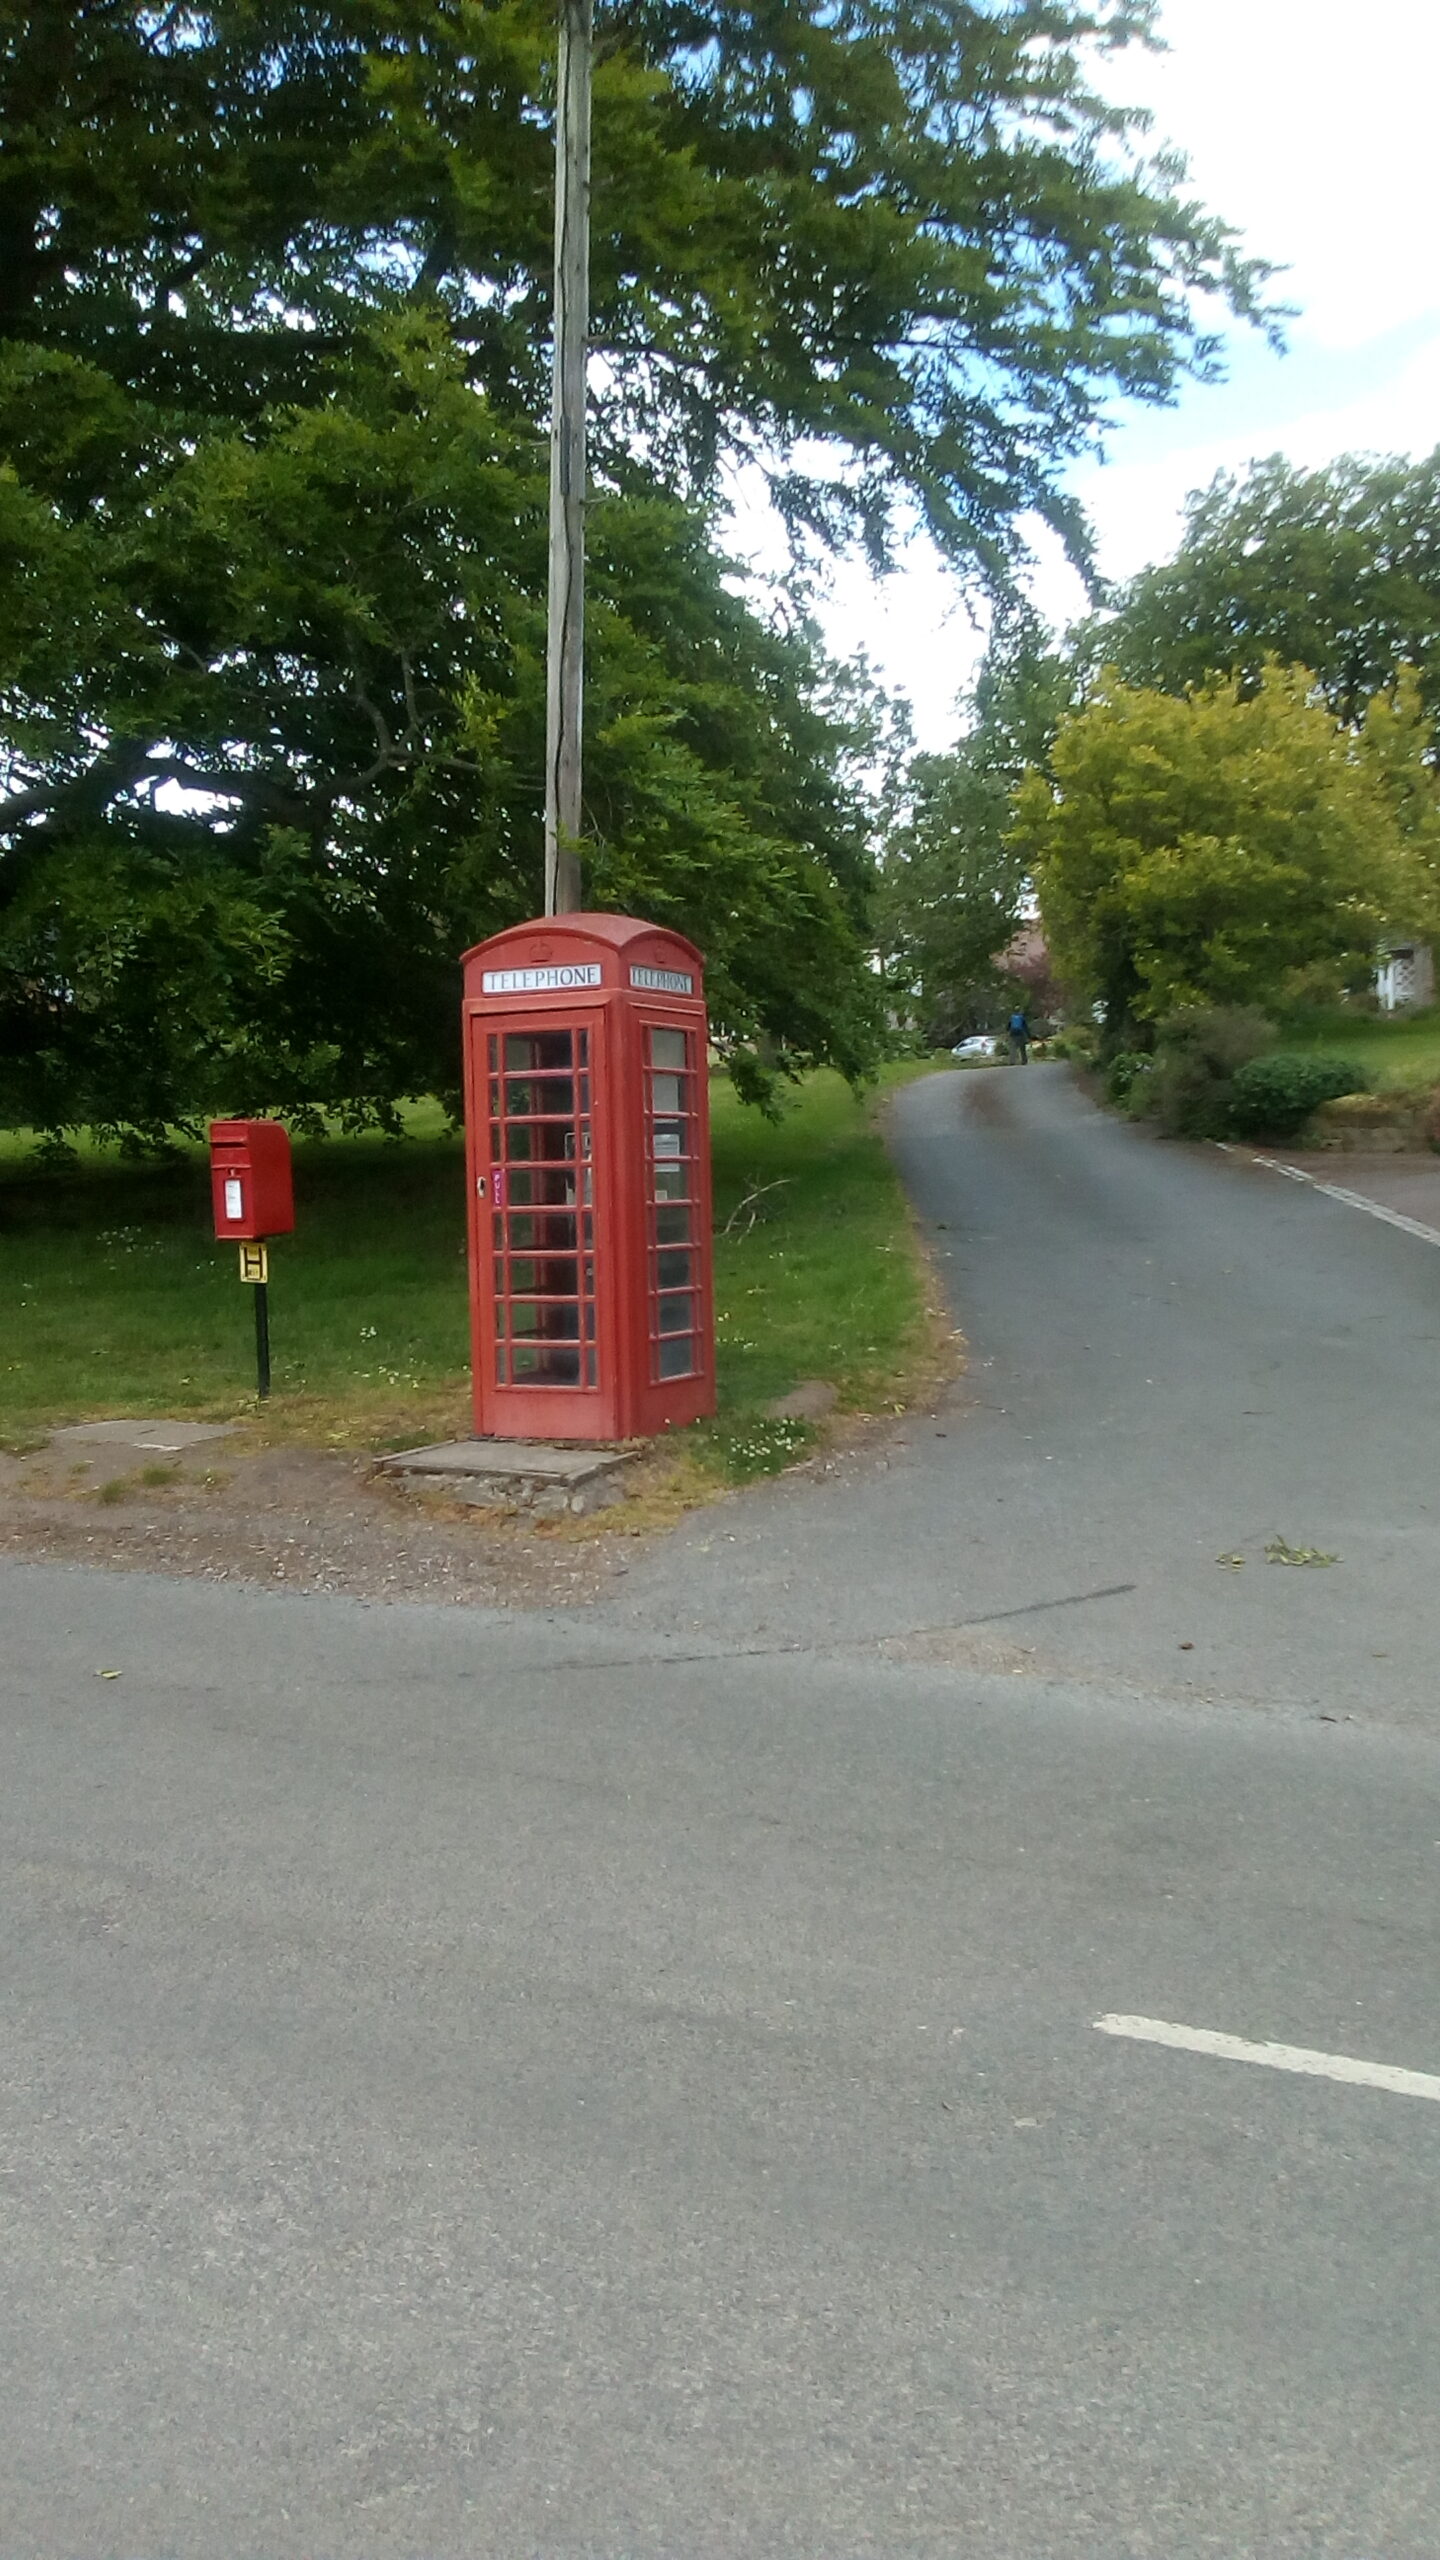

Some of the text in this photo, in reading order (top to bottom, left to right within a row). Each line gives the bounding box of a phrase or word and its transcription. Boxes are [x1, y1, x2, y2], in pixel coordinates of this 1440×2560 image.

[488, 966, 597, 990] TELEPHONE
[632, 967, 690, 992] TELEPHONE
[244, 1246, 263, 1278] H
